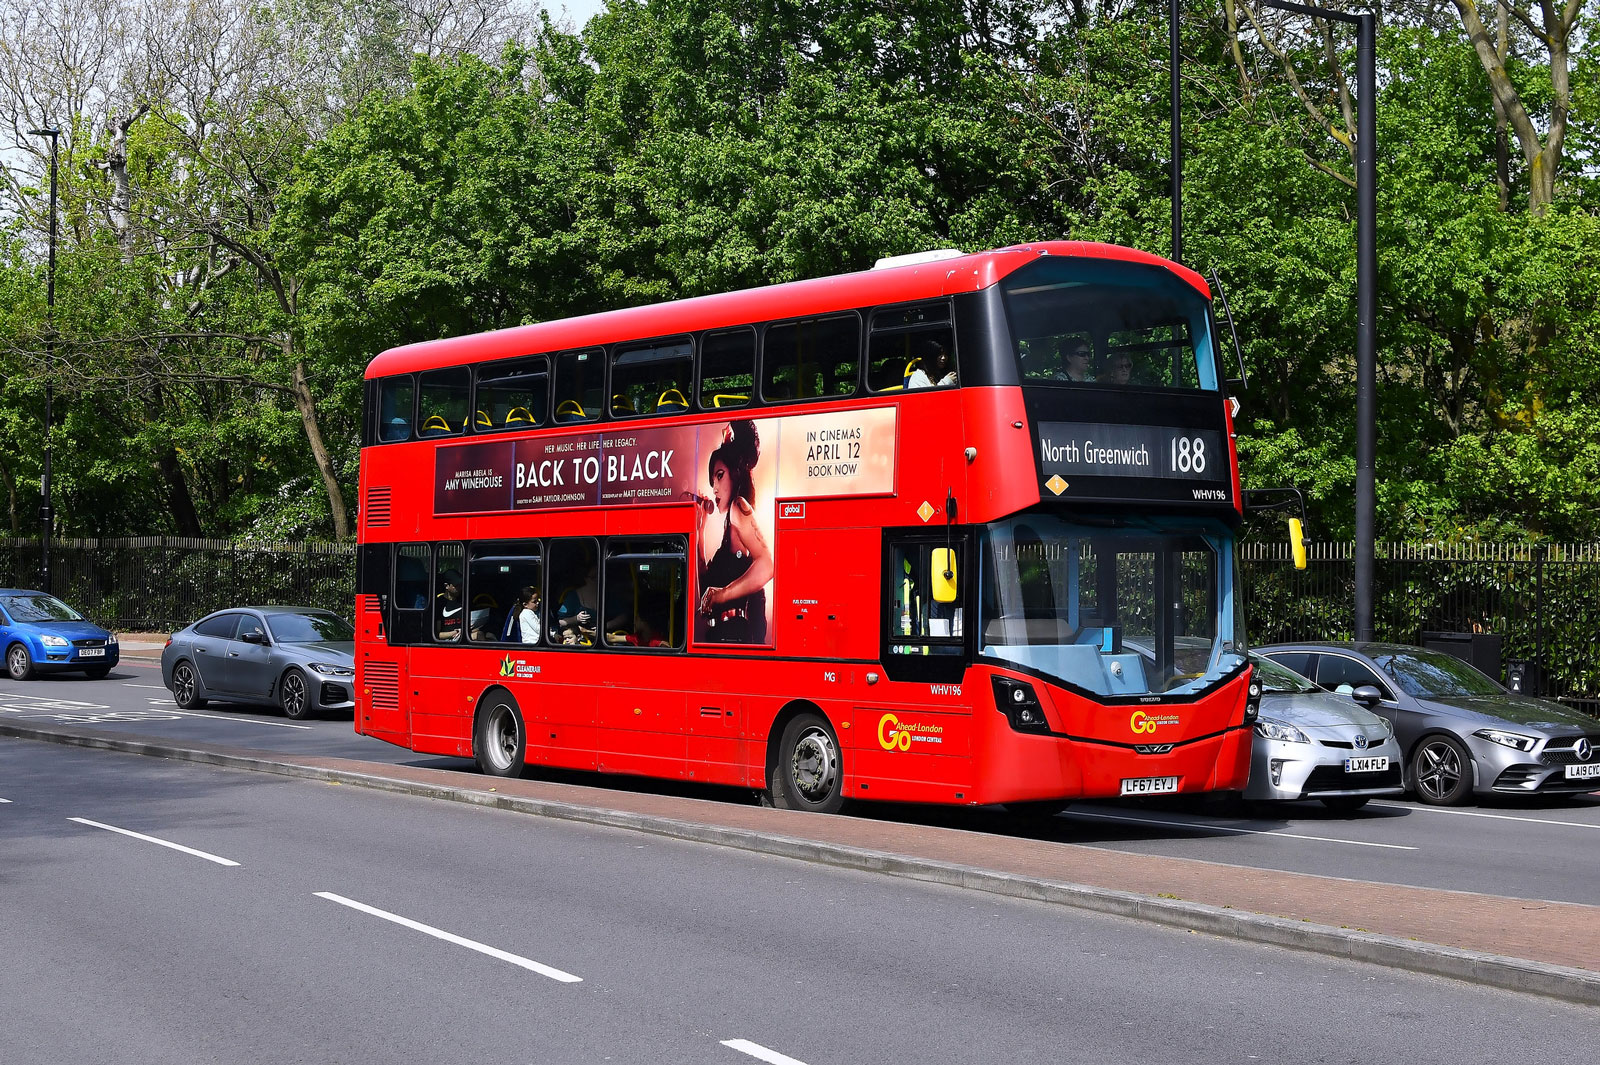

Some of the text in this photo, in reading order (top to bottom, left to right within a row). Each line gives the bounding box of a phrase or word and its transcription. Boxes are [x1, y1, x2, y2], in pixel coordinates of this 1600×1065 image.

[806, 427, 861, 442] IN CINEMAS
[544, 445, 555, 453] HER
[556, 443, 575, 452] MUSIC.
[576, 441, 587, 450] HER
[603, 439, 613, 448] HER
[615, 438, 637, 447] LEGACY.
[806, 442, 860, 462] APRIL 12
[1041, 438, 1149, 466] North Greenwich
[1171, 436, 1206, 473] 188
[455, 468, 493, 478] MARISA ABELA IS
[515, 450, 674, 489] BACK TO BLACK
[808, 463, 857, 477] BOOK NOW
[444, 476, 503, 490] AMY WINEHOUSE
[532, 495, 543, 503] SAM
[623, 489, 636, 498] MATT
[637, 488, 672, 497] GREENHALGH
[1192, 489, 1226, 500] WHV196
[784, 504, 800, 517] global
[824, 671, 836, 682] MG
[930, 684, 962, 696] WHV196
[1130, 710, 1157, 734] Go
[877, 713, 911, 752] Go
[1351, 758, 1387, 771] LX14 FLP
[1570, 764, 1600, 777] LA19 CYC
[1126, 778, 1174, 793] LF67 EYJ
